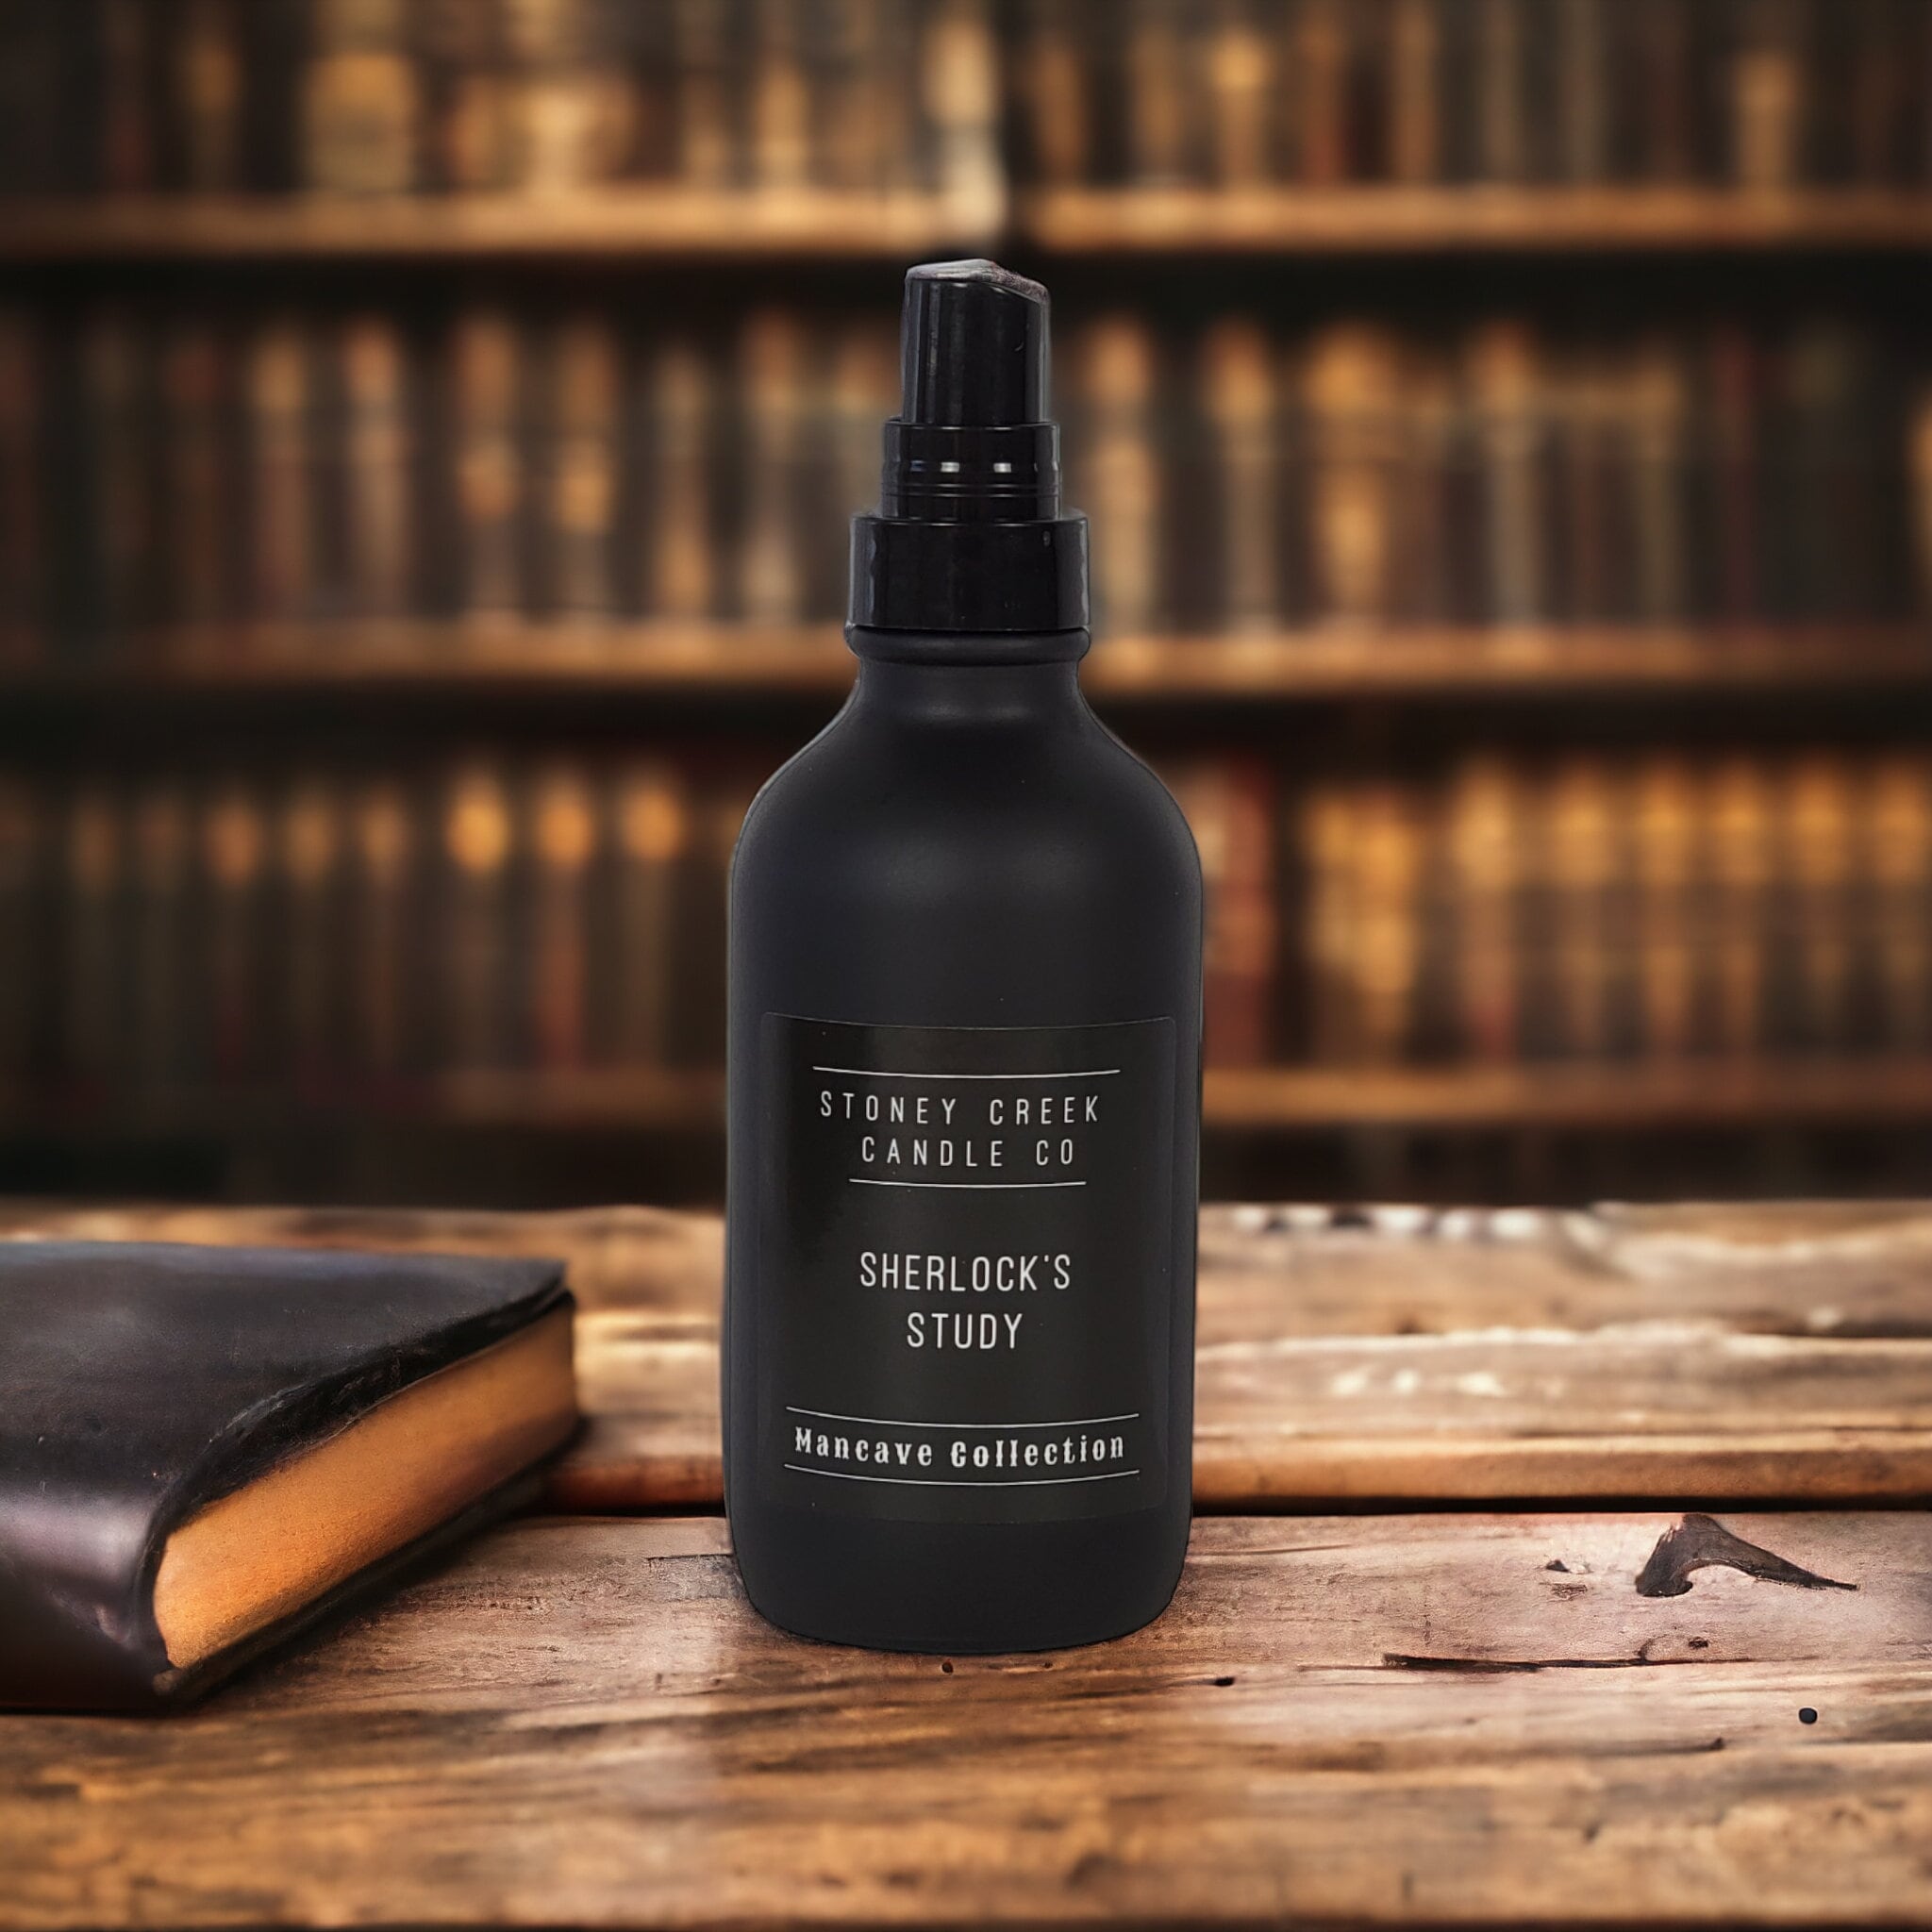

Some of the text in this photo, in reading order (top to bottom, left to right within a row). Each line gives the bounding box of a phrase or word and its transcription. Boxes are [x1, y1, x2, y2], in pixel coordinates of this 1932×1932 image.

[820, 1091, 1099, 1126] STONEY CREEK
[861, 1136, 1074, 1167] CANDLE CO
[859, 1251, 1071, 1292] SHERLOCK'S
[907, 1312, 1023, 1350] STUDY
[795, 1425, 1124, 1468] Mancave Collection
